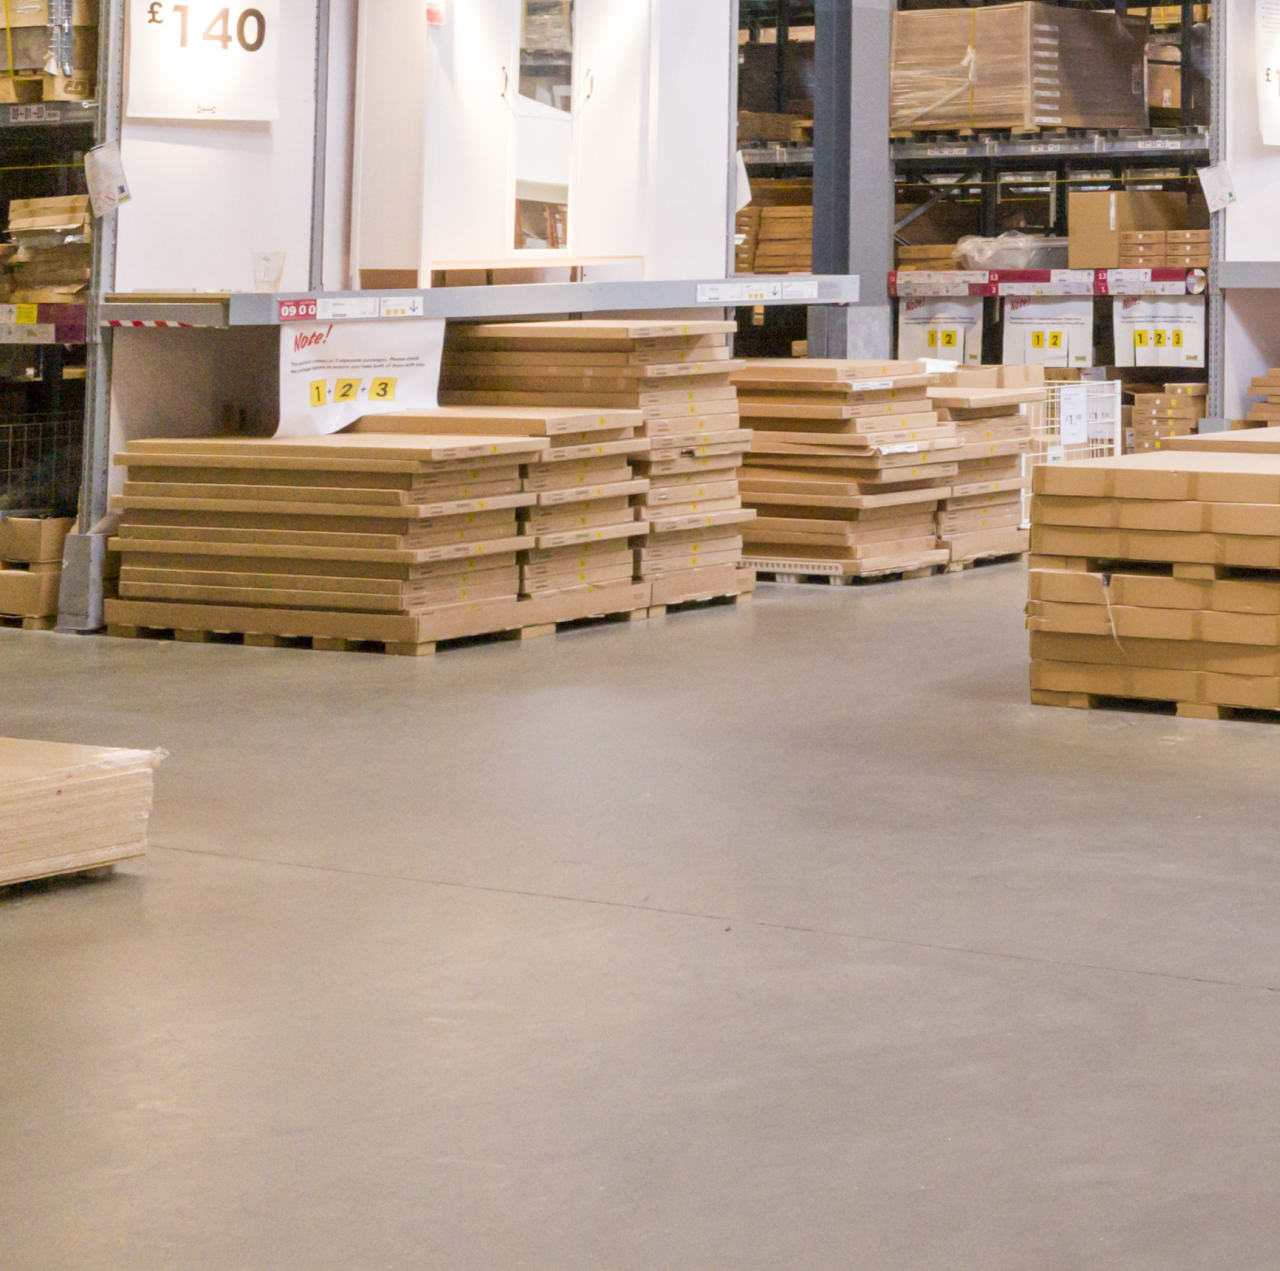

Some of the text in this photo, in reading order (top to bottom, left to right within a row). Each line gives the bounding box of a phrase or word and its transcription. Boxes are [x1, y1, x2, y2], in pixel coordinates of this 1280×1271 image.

[147, 1, 266, 52] £140
[294, 322, 333, 353] Note!
[945, 334, 952, 345] 2
[1052, 335, 1058, 346] 2
[1156, 333, 1162, 344] 2
[315, 386, 321, 402] 1
[340, 383, 353, 398] 2
[375, 382, 389, 398] 3
